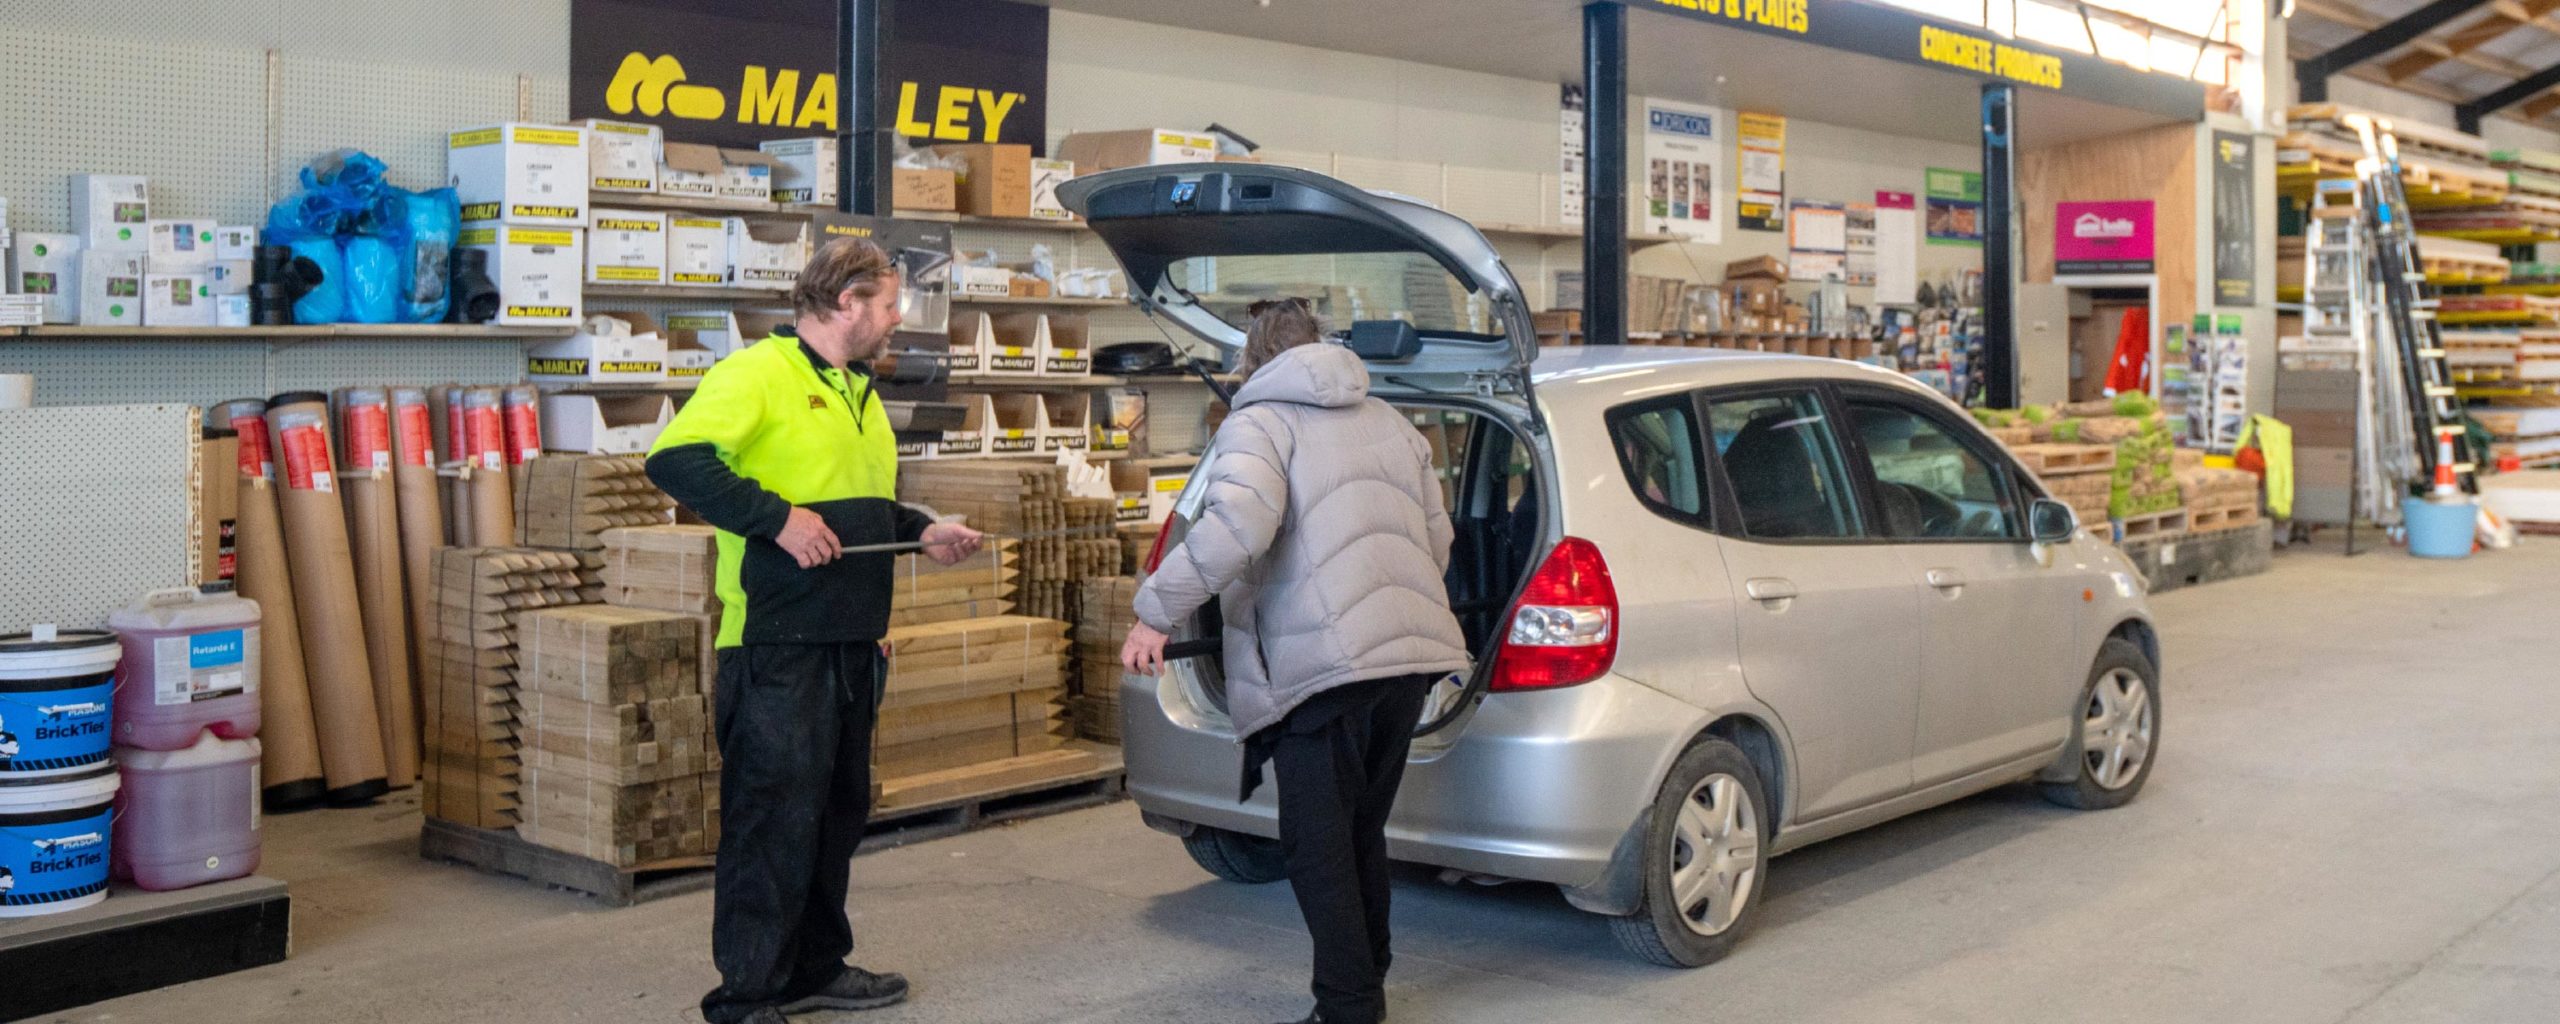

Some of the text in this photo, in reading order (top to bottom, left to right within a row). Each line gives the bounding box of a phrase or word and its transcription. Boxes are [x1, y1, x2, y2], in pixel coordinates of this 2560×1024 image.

[1745, 0, 1808, 34] PLATES
[1920, 24, 2063, 90] CONCRETE PRODUCTS
[737, 64, 1021, 143] MALEY
[1663, 112, 1710, 136] DRICON
[612, 178, 648, 189] MARLEY
[464, 202, 499, 221] MARLEY
[532, 205, 575, 218] MARLEY
[838, 225, 873, 238] MARLEY
[527, 306, 570, 318] MARLEY
[543, 358, 586, 375] MARLEY
[618, 361, 659, 373] MARLEY
[1004, 357, 1034, 368] MARLEY
[1060, 360, 1088, 370] MARLEY
[951, 440, 981, 450] MARLEY
[1006, 438, 1035, 449] MARLEY
[35, 721, 105, 740] Brick Ties
[30, 853, 101, 874] Brick Ties
